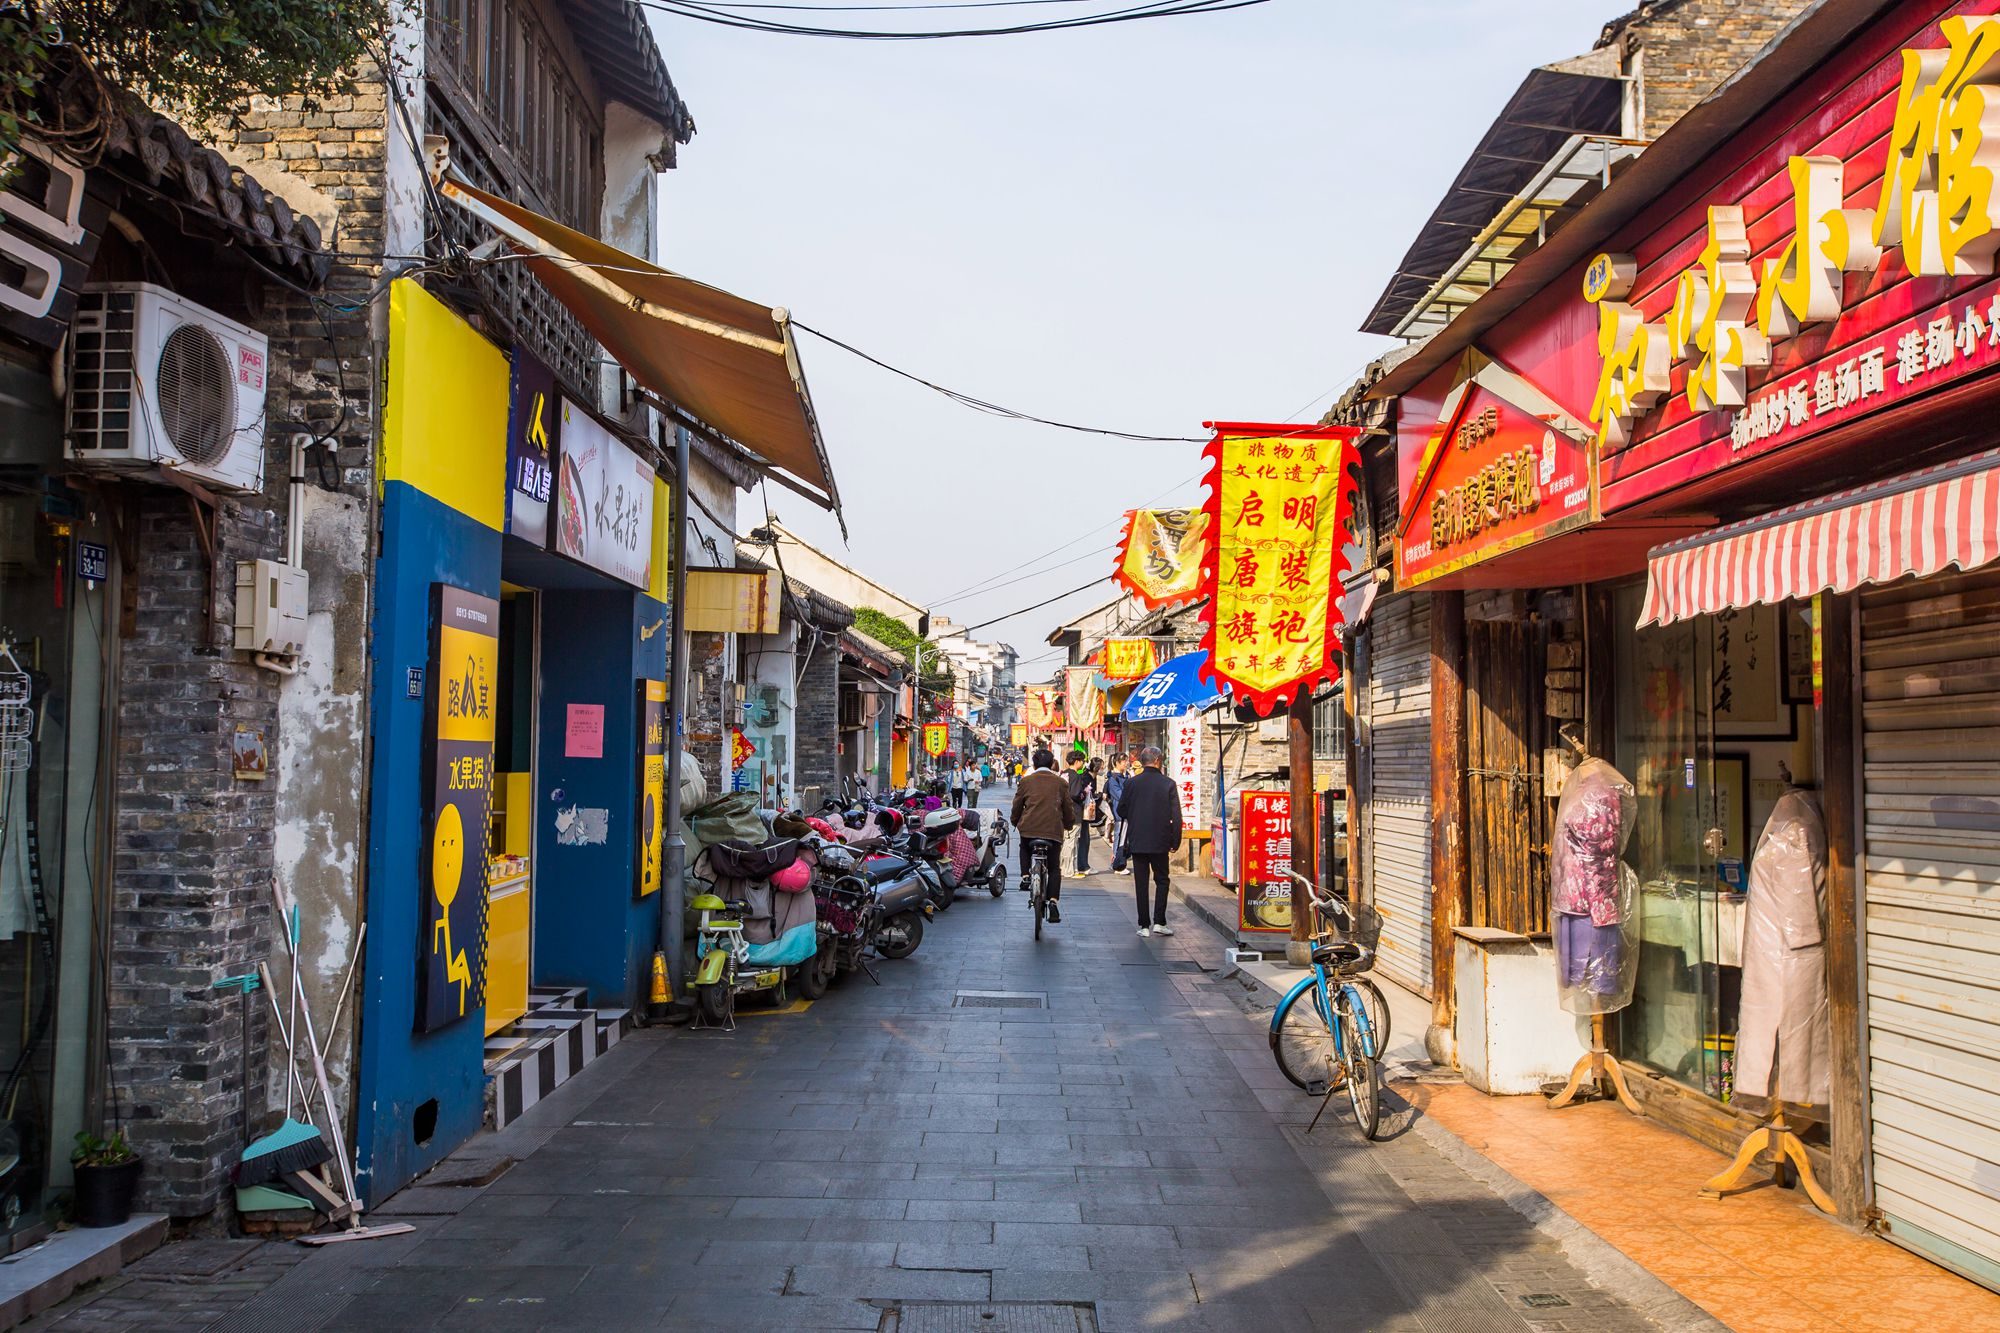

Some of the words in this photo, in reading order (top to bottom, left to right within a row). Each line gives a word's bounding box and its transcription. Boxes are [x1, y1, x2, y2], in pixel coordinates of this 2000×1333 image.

[240, 346, 263, 369] YAIR
[1731, 379, 1810, 451] 扬州炒饭
[1814, 346, 1886, 416] 鱼汤面
[1247, 442, 1319, 460] 非物质
[523, 457, 552, 502] 路人某
[1231, 463, 1330, 485] 文化遗产
[594, 468, 639, 552] 水果捞
[1233, 489, 1319, 531] 启明
[1228, 547, 1311, 593] 唐装
[1223, 608, 1310, 646] 旗袍
[1223, 653, 1315, 674] 百年老店
[1137, 672, 1178, 705] 动
[1137, 702, 1178, 717] 状态全开
[1180, 727, 1197, 776] 好吃又健康
[448, 756, 484, 790] 水果捞
